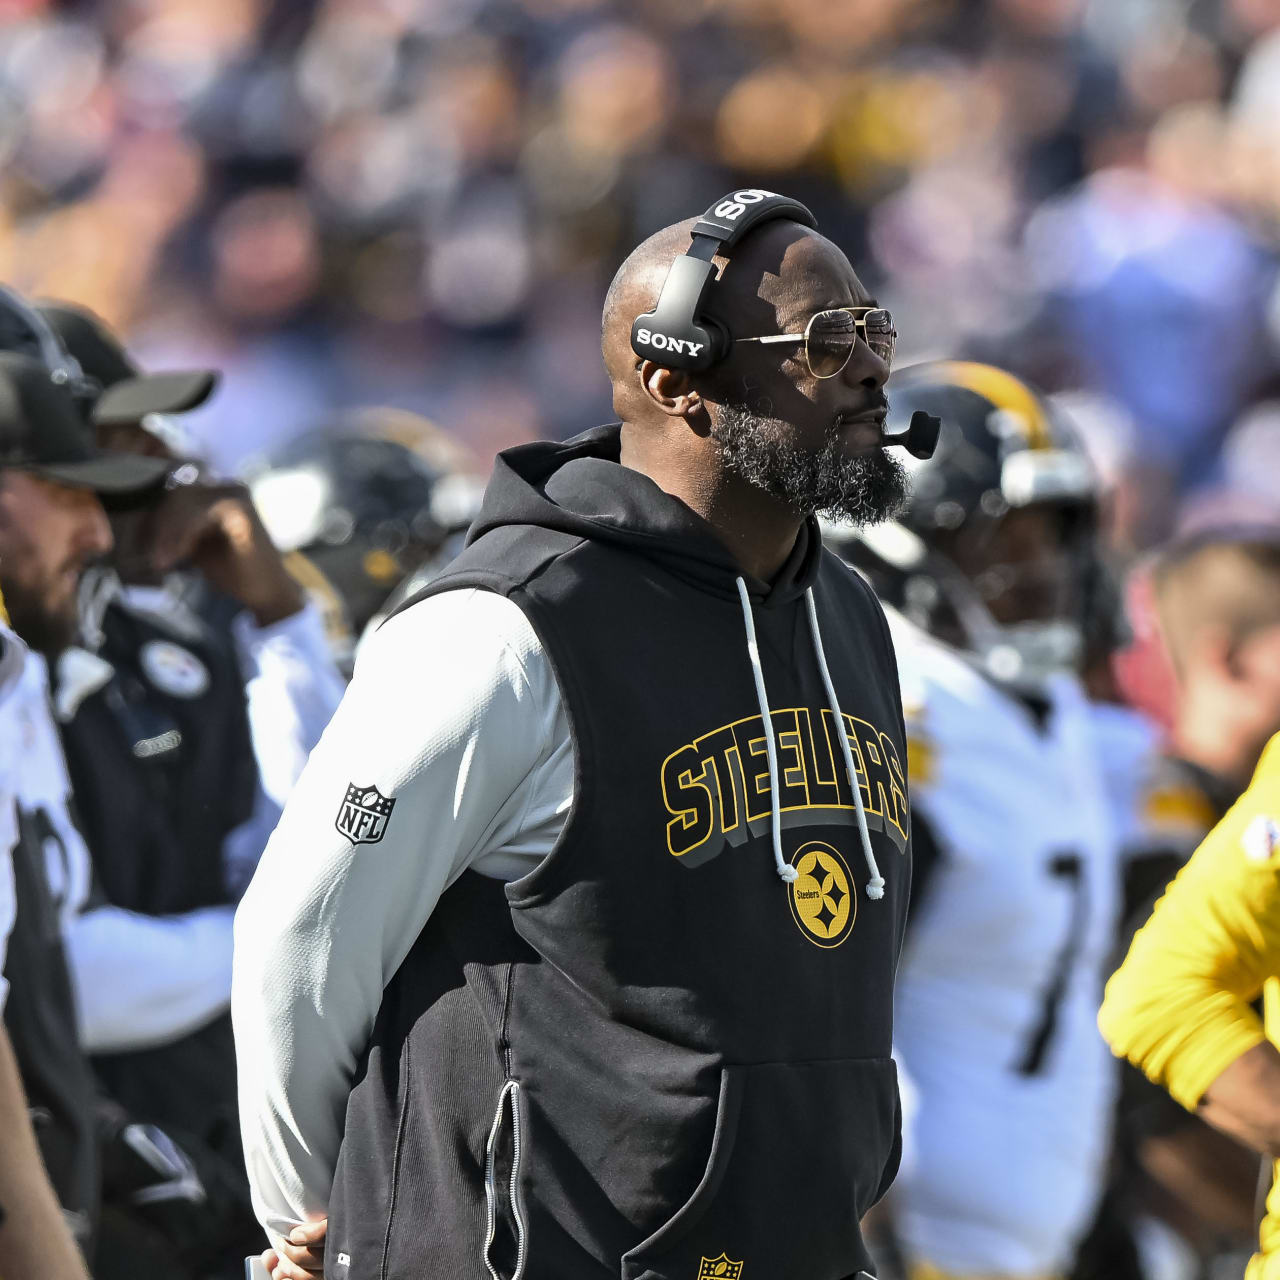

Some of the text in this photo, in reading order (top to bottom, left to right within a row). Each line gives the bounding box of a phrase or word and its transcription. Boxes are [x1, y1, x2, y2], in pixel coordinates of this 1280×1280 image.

[636, 328, 704, 357] SONY
[660, 707, 909, 858] STEELERS
[339, 804, 382, 840] NFL
[796, 888, 821, 900] Steelers
